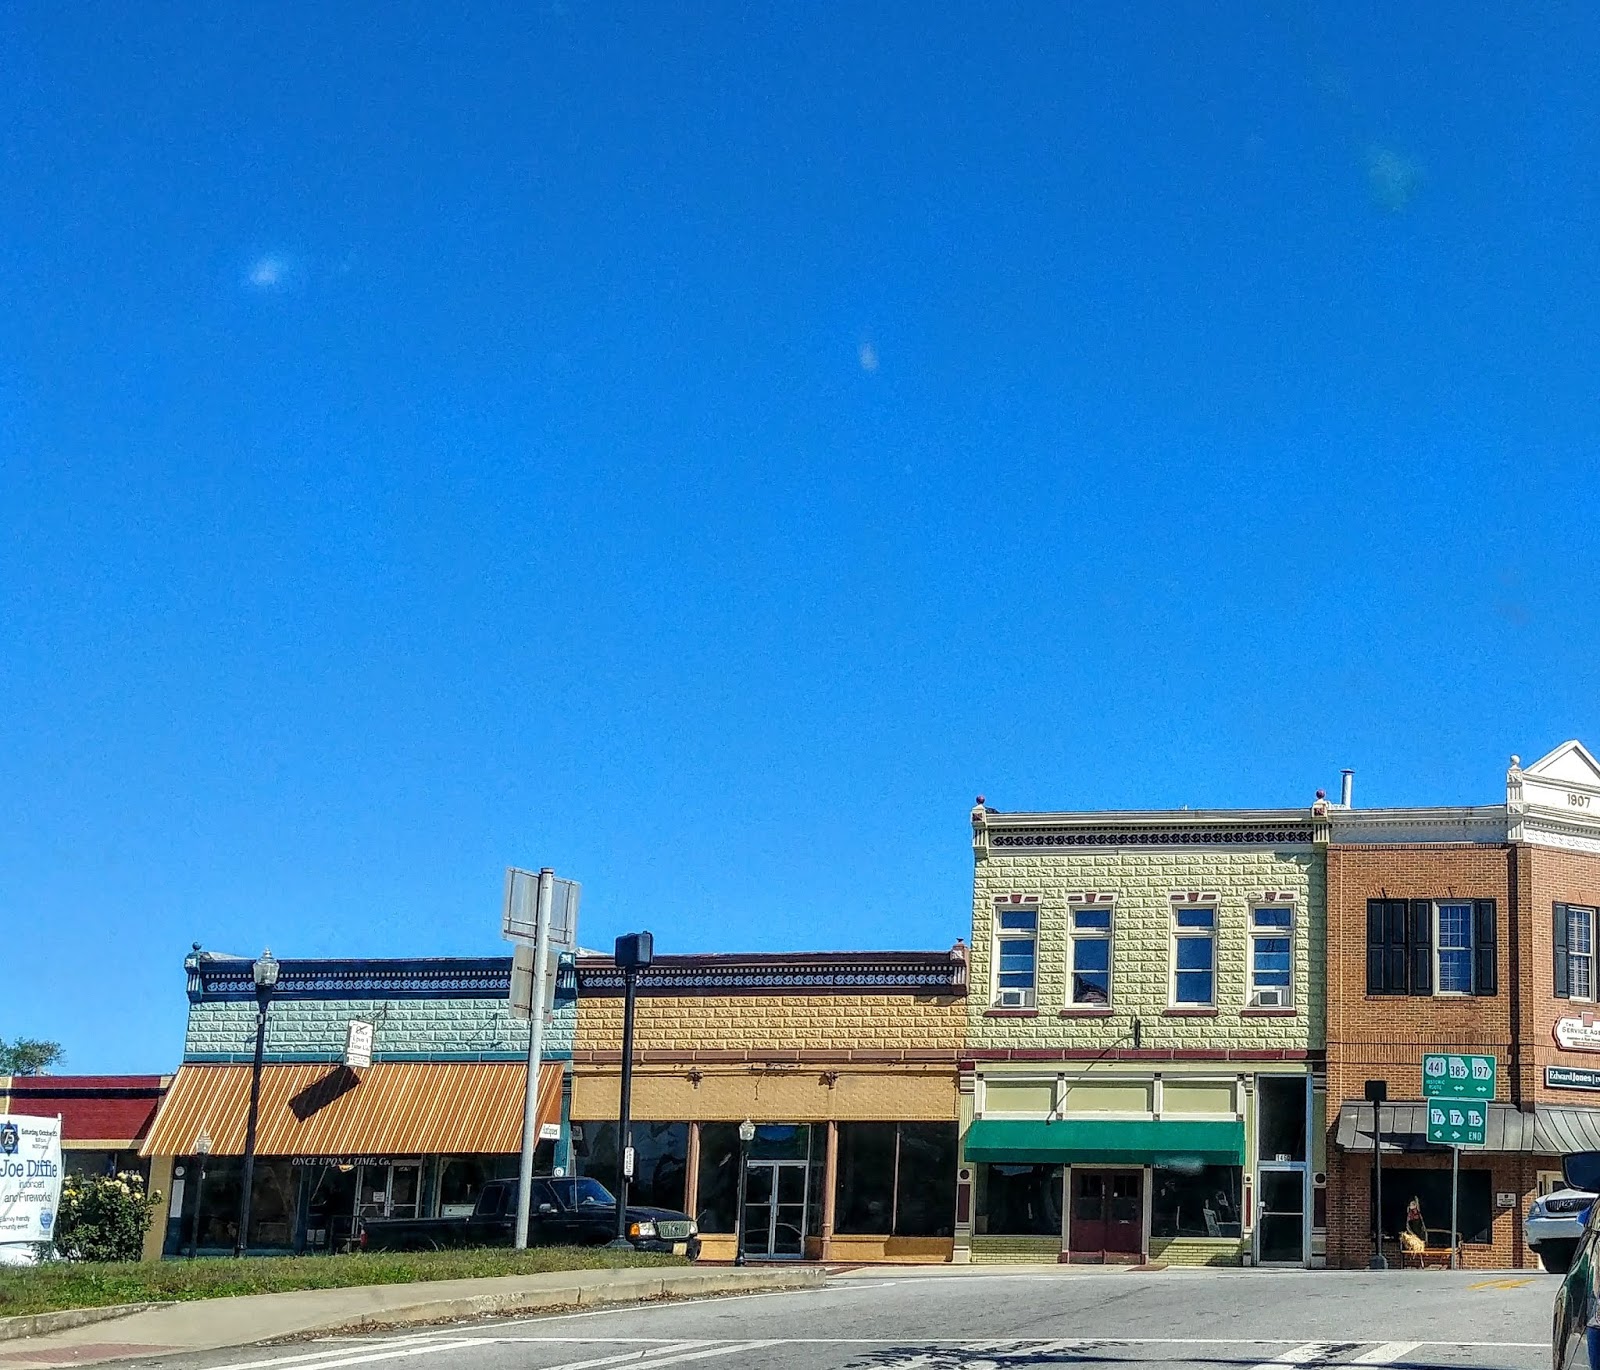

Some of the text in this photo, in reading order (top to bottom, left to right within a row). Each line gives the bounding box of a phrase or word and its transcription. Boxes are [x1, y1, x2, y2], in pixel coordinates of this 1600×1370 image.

[1567, 793, 1591, 808] 1907
[1428, 1062, 1443, 1073] 441
[1450, 1065, 1466, 1077] 385
[1474, 1066, 1488, 1077] 197
[1549, 1070, 1572, 1081] Edward
[1572, 1072, 1592, 1082] Jones
[1432, 1114, 1442, 1123] 17
[1451, 1114, 1460, 1123] 17
[1469, 1115, 1481, 1124] 115
[3, 1129, 15, 1145] 75
[1468, 1131, 1482, 1141] END
[291, 1157, 391, 1166] ONCE UPON A TIME, Co.
[0, 1159, 58, 1178] Joe Diffie
[23, 1180, 45, 1188] concert
[4, 1192, 18, 1202] and
